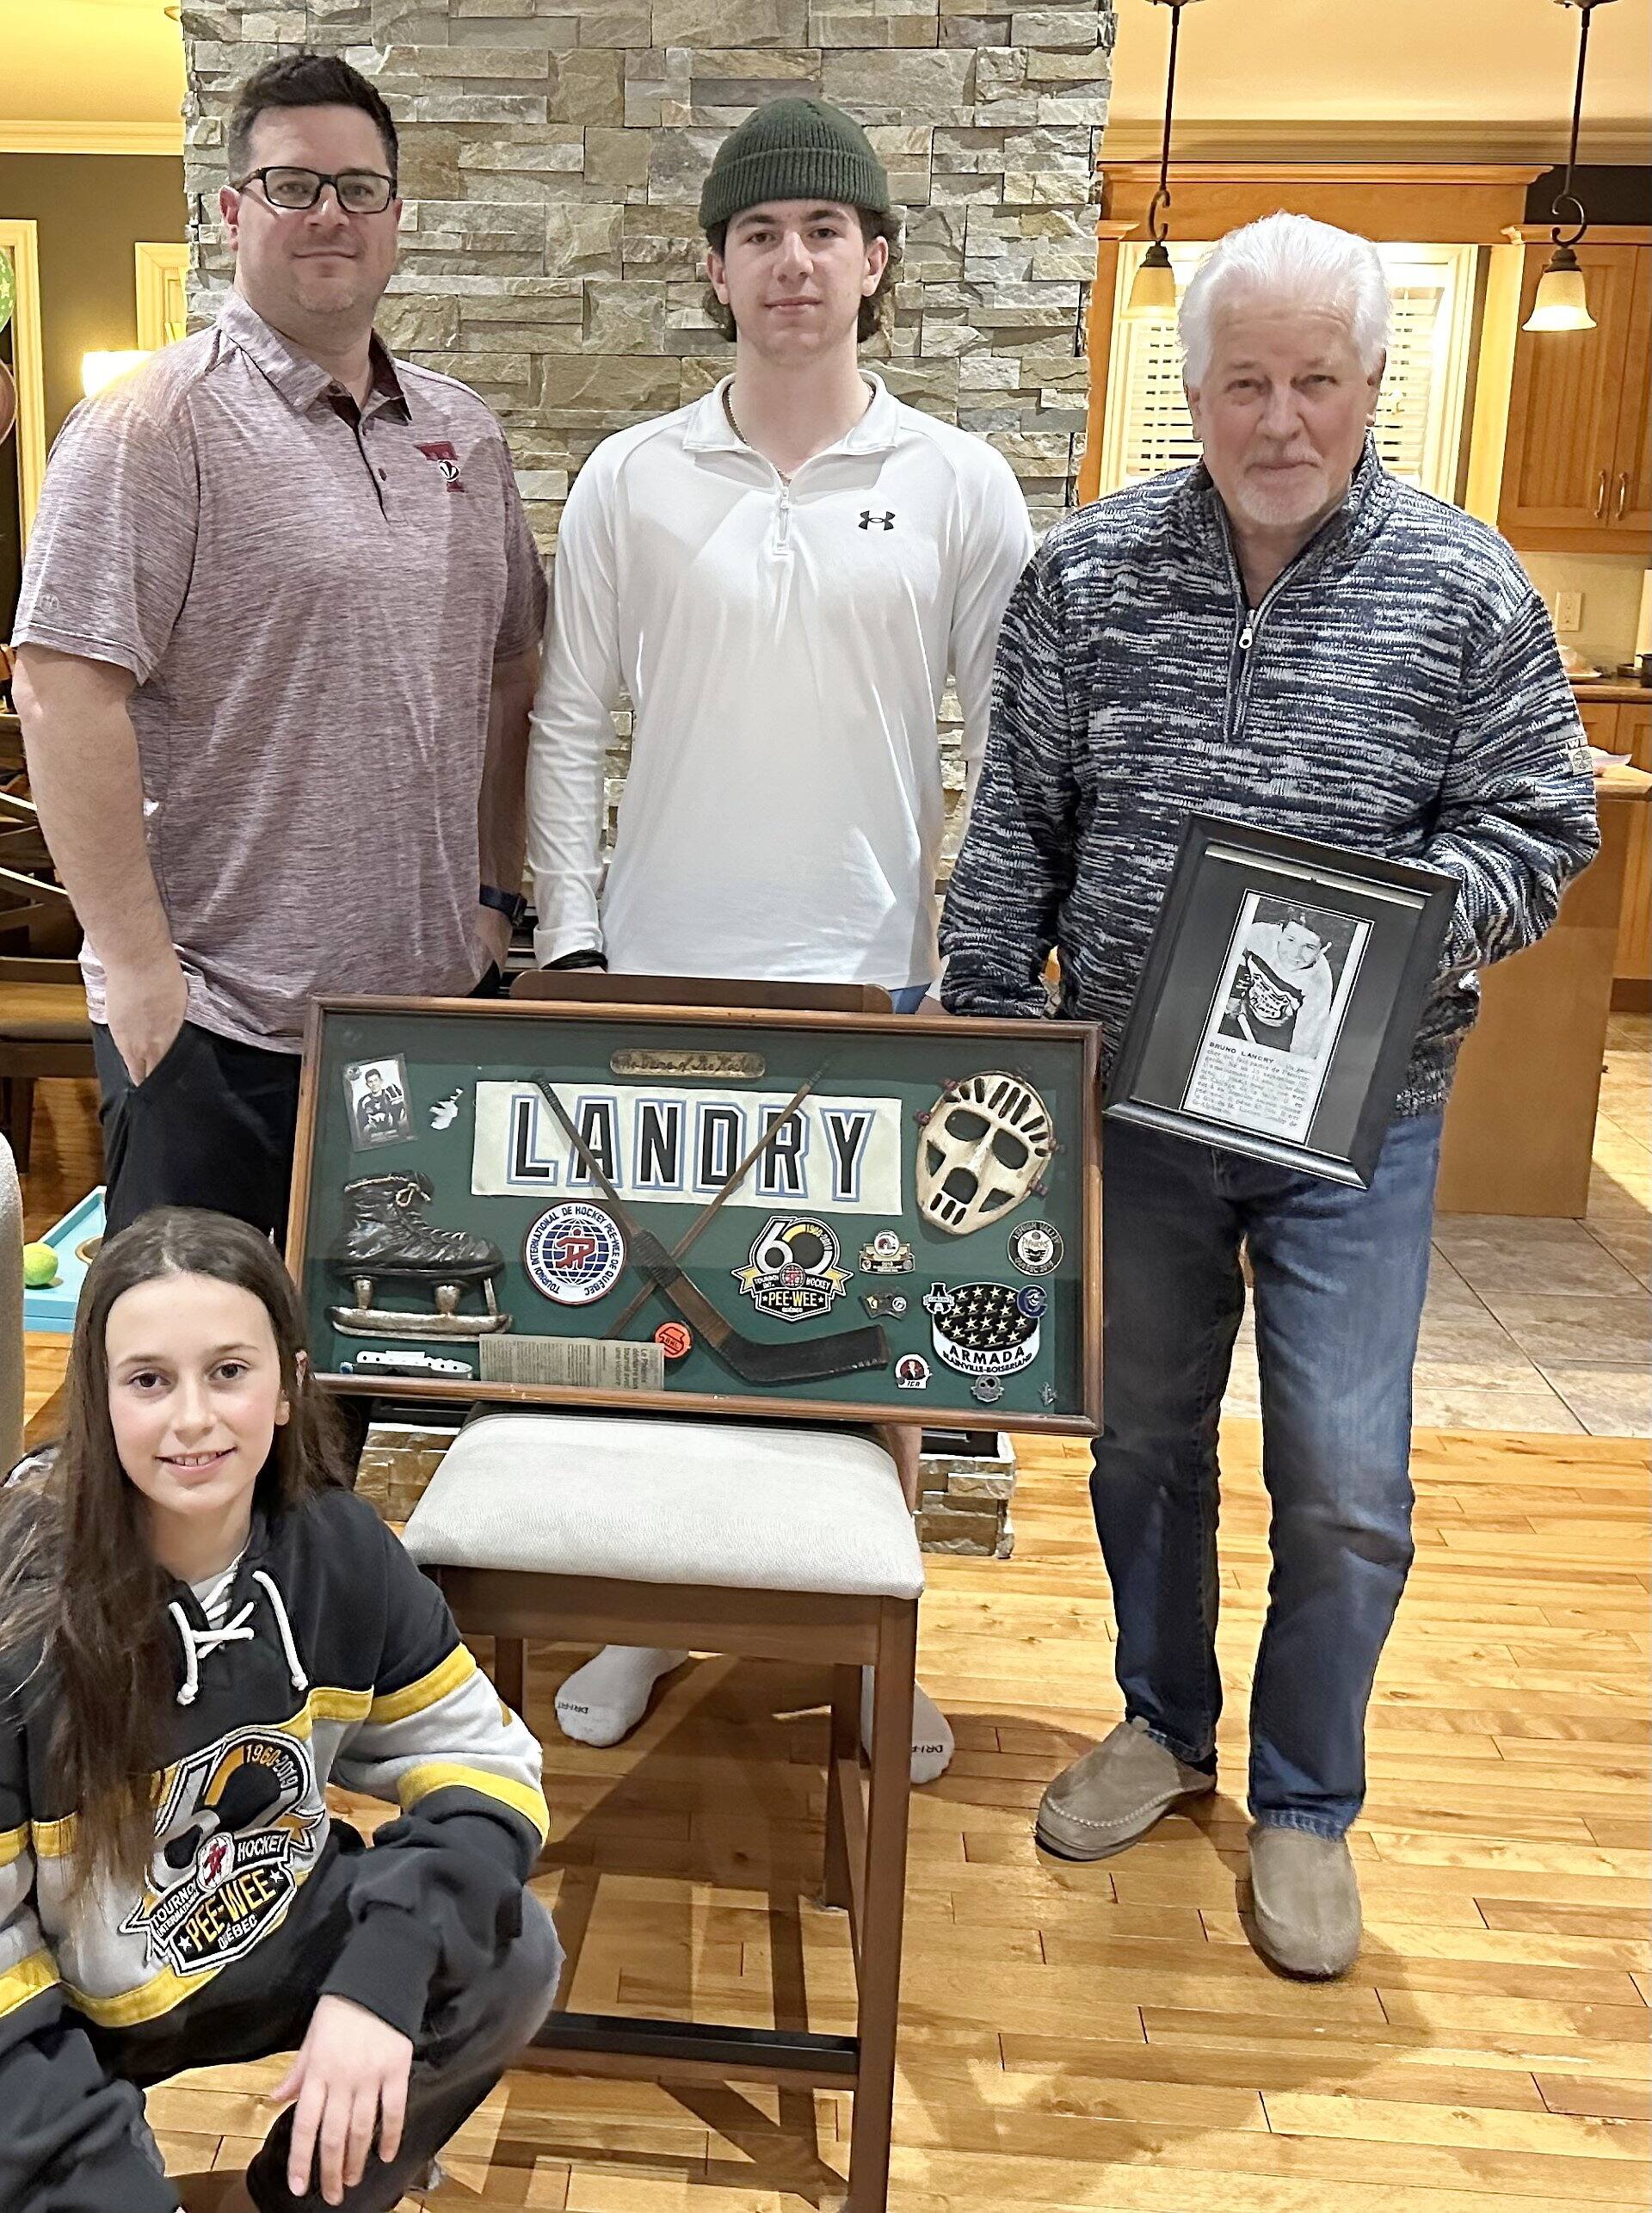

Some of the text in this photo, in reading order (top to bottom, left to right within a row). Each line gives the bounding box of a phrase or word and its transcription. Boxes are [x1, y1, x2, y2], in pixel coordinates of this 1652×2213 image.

[1209, 1041, 1236, 1054] BRUNO
[507, 1094, 877, 1202] LANDRY
[562, 1205, 573, 1215] DE
[575, 1205, 607, 1224] HOCKEY
[530, 1211, 559, 1266] INTERNATIONAL
[604, 1223, 620, 1257] PEE-WEE
[609, 1259, 619, 1270] DE
[533, 1267, 560, 1294] TOURNOI
[806, 1277, 831, 1291] HOCKEY
[949, 1346, 1025, 1365] ARMADA
[911, 1744, 943, 1754] DRI-F
[246, 1743, 299, 1789] 1960-2019
[237, 1834, 287, 1862] HOCKEY
[185, 1868, 277, 1952] PEE-WEE
